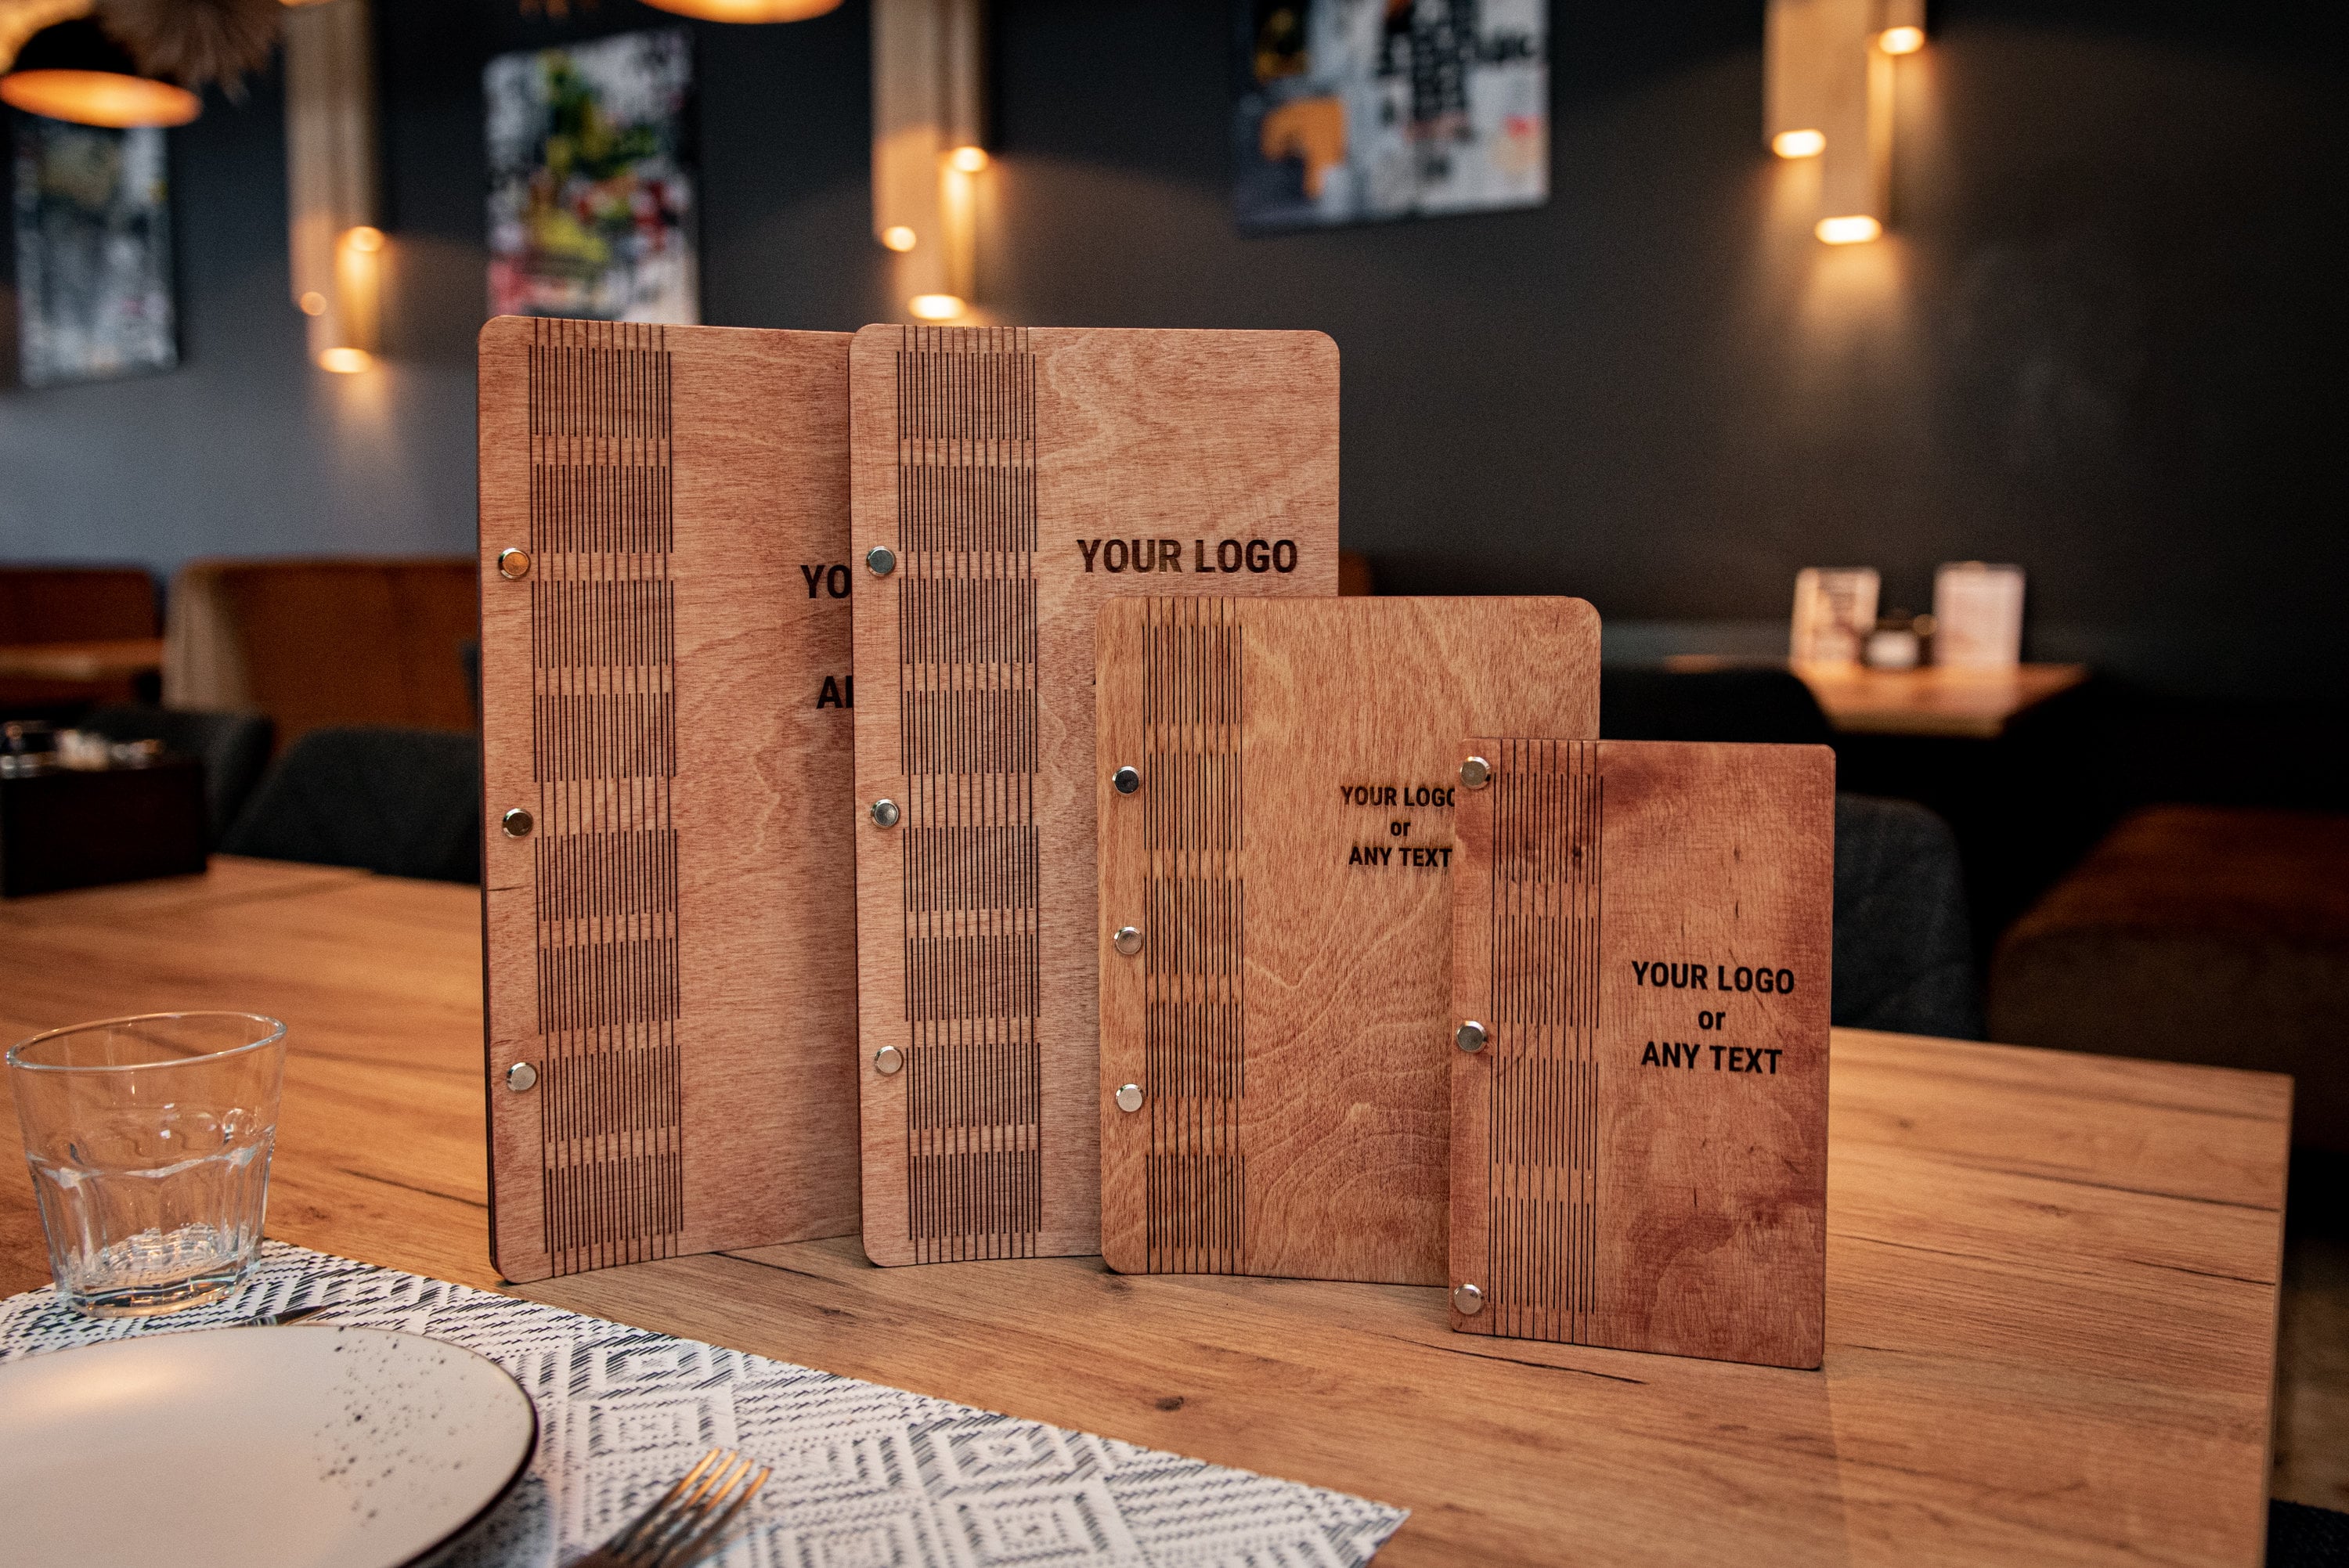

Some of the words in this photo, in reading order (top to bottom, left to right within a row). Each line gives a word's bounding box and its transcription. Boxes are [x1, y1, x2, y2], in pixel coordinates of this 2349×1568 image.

[1077, 539, 1182, 573] YOUR
[1195, 539, 1298, 573] LOGO
[1340, 785, 1397, 806] YOUR
[1390, 821, 1411, 837] or
[1348, 845, 1392, 867] ANY
[1398, 847, 1453, 867] TEXT
[1631, 961, 1708, 990] YOUR
[1718, 965, 1795, 994] LOGO
[1698, 1010, 1726, 1030] or
[1641, 1041, 1701, 1069] ANY
[1709, 1045, 1783, 1075] TEXT
